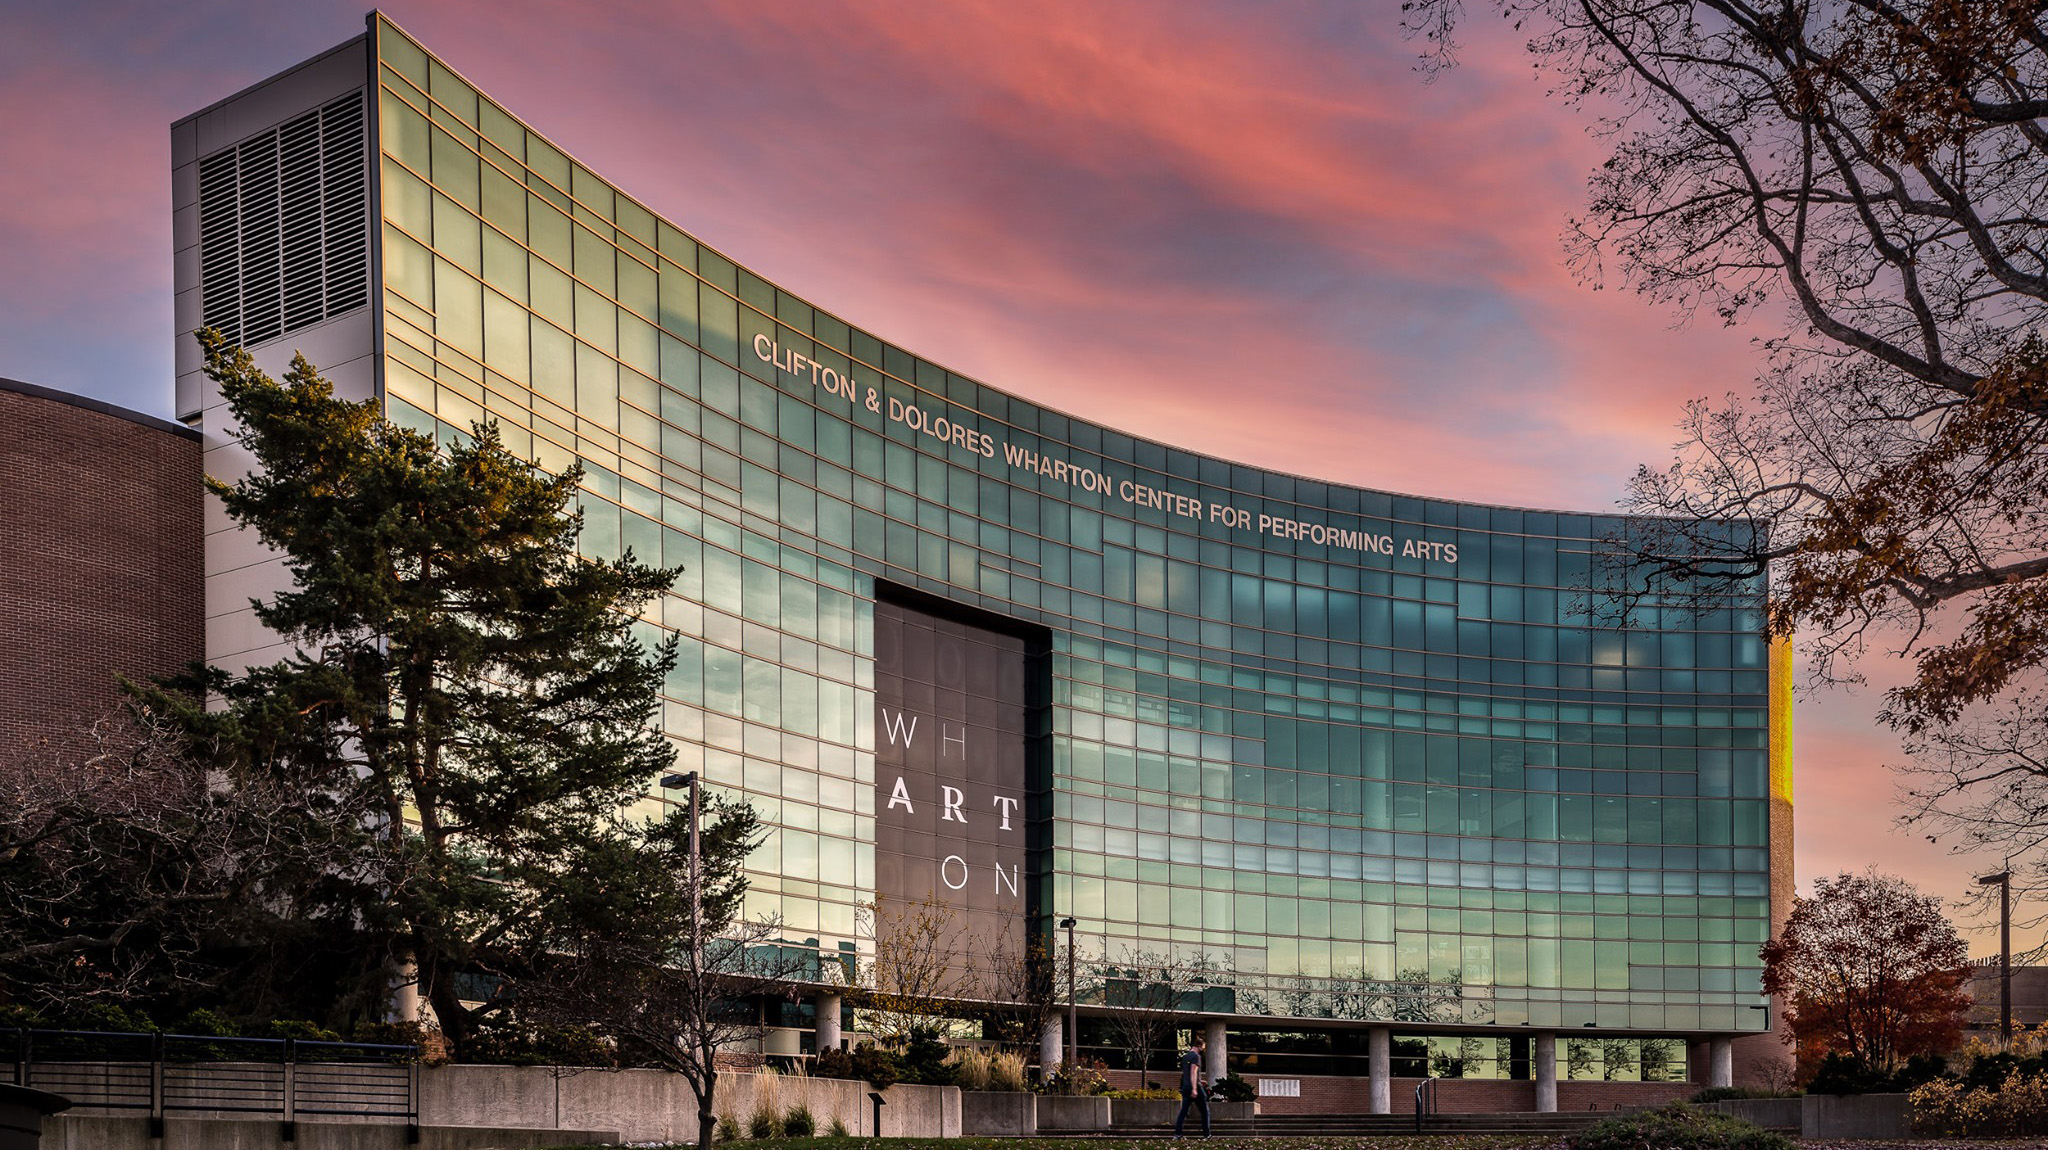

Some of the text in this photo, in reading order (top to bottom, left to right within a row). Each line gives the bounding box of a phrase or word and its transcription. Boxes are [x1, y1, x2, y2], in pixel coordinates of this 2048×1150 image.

[753, 334, 1458, 563] CLIFTON & DOLORES WHARTON CENTER FOR PERFORMING ARTS
